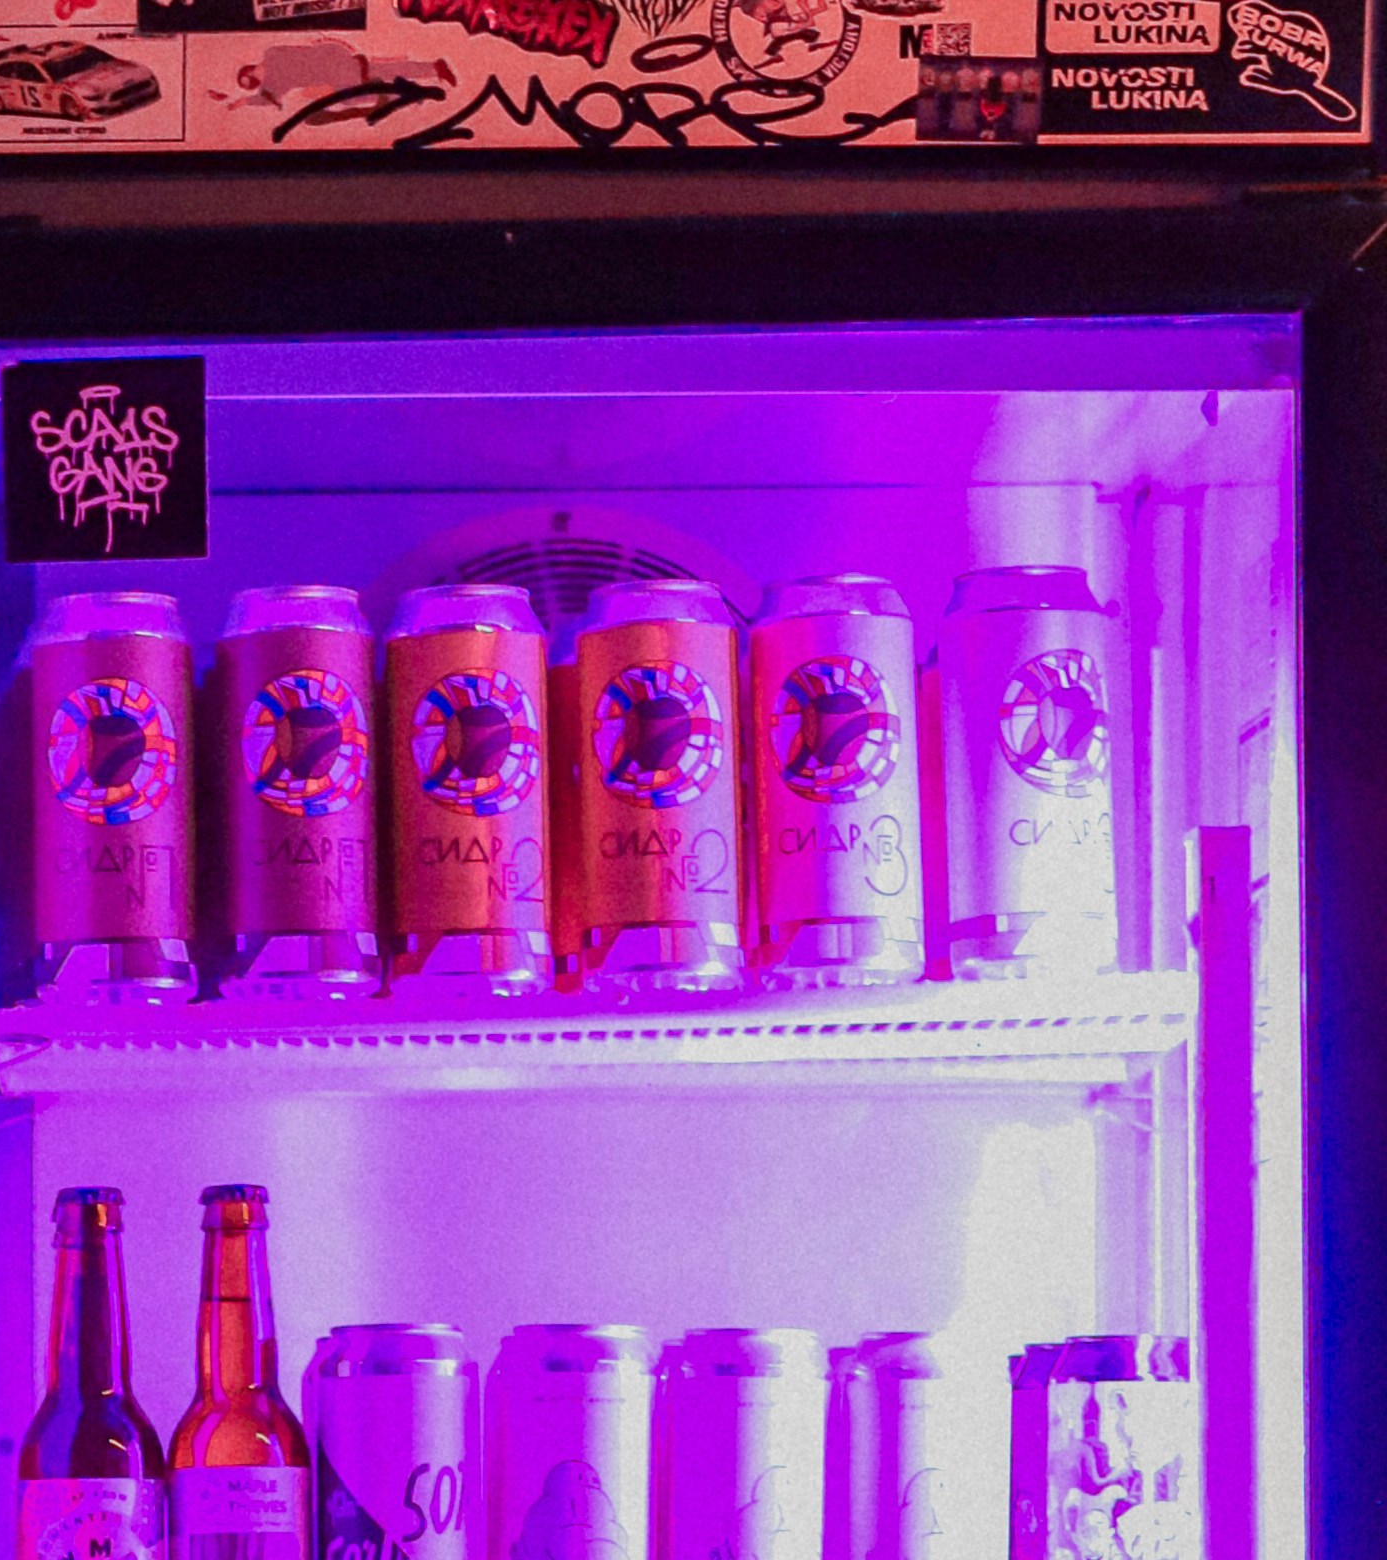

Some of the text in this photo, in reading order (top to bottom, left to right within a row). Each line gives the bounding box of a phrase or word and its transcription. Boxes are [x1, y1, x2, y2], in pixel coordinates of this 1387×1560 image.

[1053, 2, 1196, 22] NOVOSTI
[1093, 24, 1210, 46] LUKINA
[1236, 4, 1324, 52] BOBR
[1051, 66, 1195, 88] NOVOSTI
[1090, 88, 1210, 112] LUKINA
[49, 450, 169, 502] GANG
[227, 1478, 278, 1494] MAPLE
